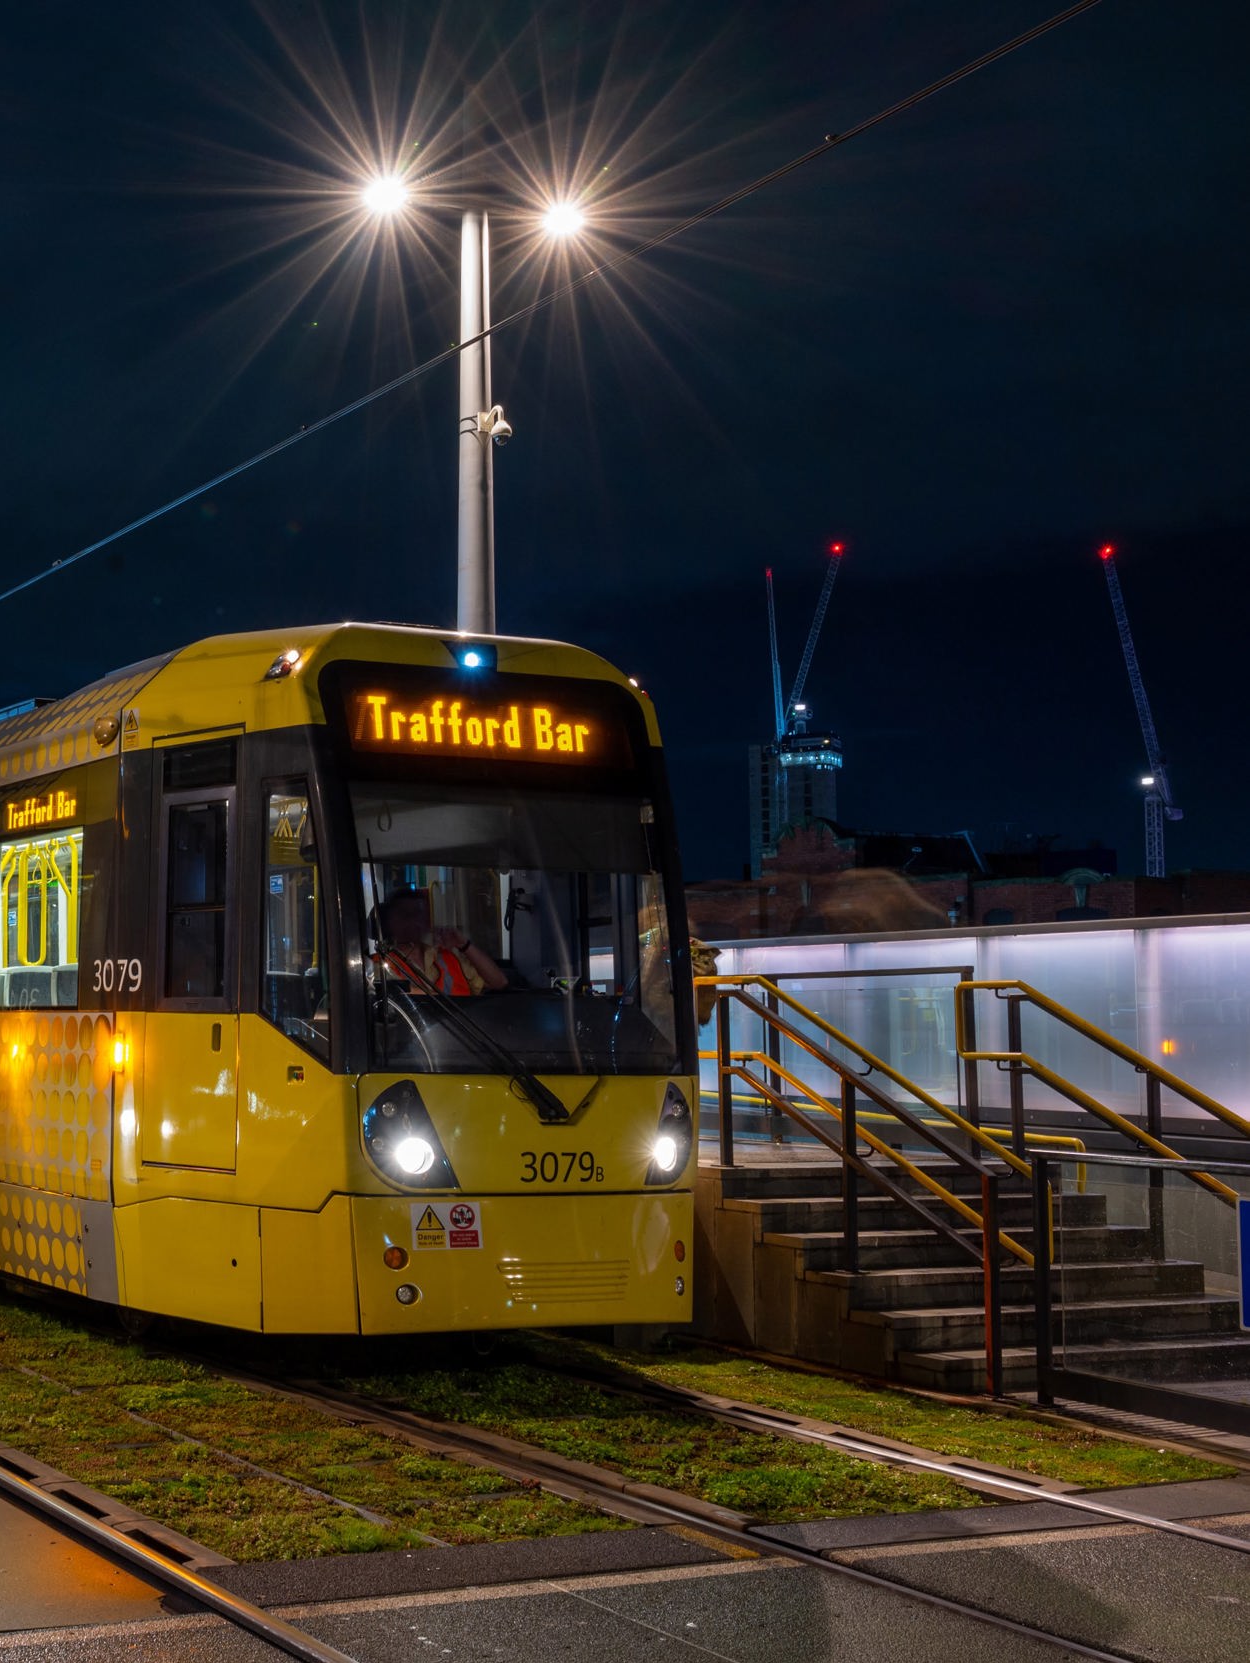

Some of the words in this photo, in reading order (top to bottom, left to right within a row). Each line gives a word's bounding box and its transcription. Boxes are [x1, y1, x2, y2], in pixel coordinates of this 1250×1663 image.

[367, 696, 521, 748] Trafford
[533, 708, 589, 752] Bar
[7, 793, 53, 829] Trafford
[57, 791, 77, 819] Bar
[92, 959, 142, 992] 3079
[417, 1234, 443, 1242] Danger
